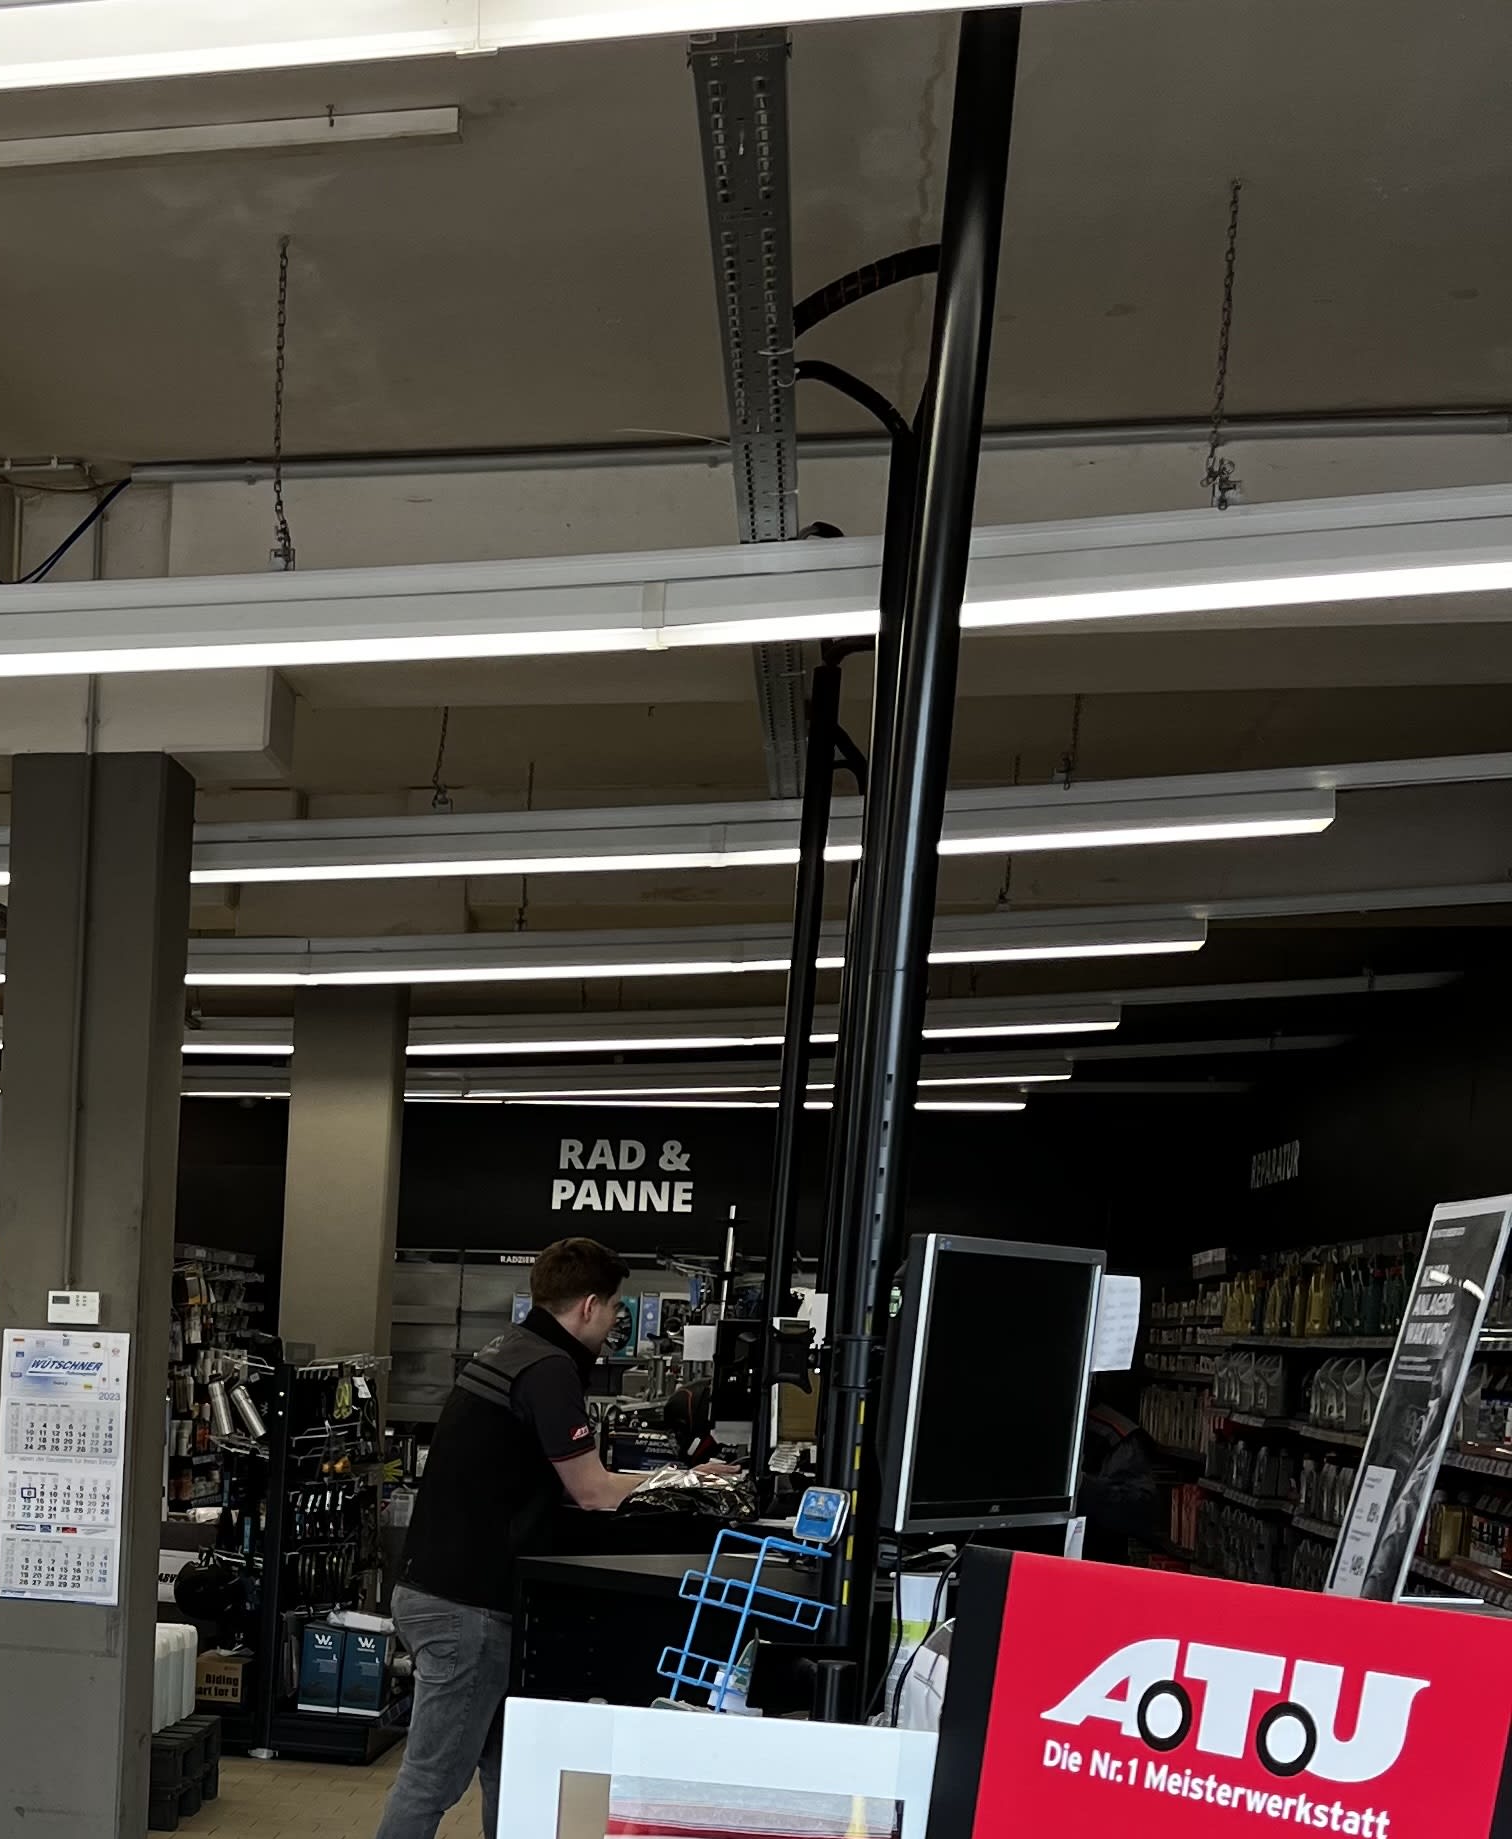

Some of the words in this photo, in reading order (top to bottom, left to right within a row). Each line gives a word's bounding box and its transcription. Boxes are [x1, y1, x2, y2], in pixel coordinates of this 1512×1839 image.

[559, 1139, 645, 1171] RAD
[659, 1140, 691, 1172] &
[1251, 1140, 1300, 1190] REPARATUR
[551, 1179, 693, 1213] PANNE
[99, 1392, 120, 1401] 2023
[214, 1687, 230, 1698] for
[232, 1687, 239, 1698] U
[1043, 1739, 1082, 1773] Die
